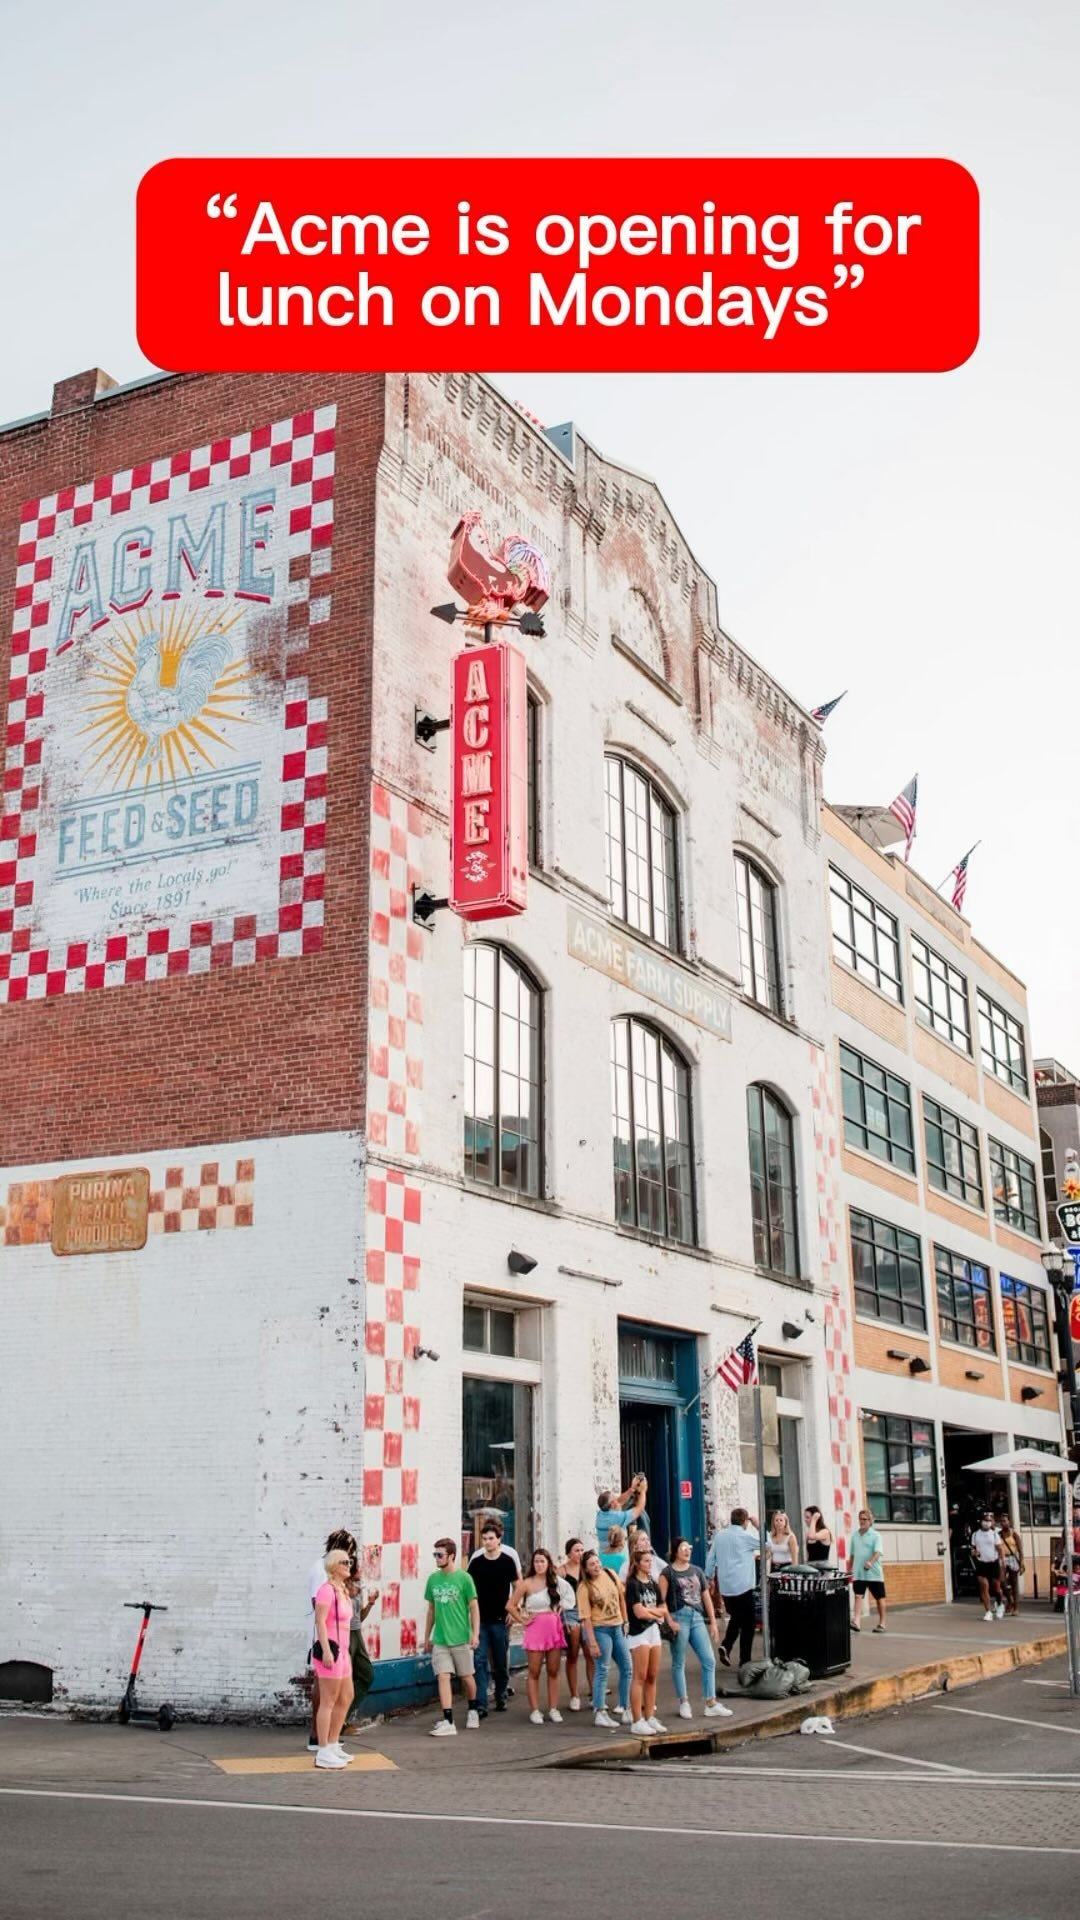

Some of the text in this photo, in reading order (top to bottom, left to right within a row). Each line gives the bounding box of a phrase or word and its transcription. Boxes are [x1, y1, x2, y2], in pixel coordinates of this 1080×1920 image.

[55, 487, 276, 656] ACME
[461, 659, 493, 846] ACME
[58, 779, 260, 865] FEED & SEED
[109, 890, 191, 920] Since 1891
[129, 877, 152, 895] the
[574, 919, 729, 1034] ACME FARM SUPPLY
[69, 1178, 136, 1201] PURINA
